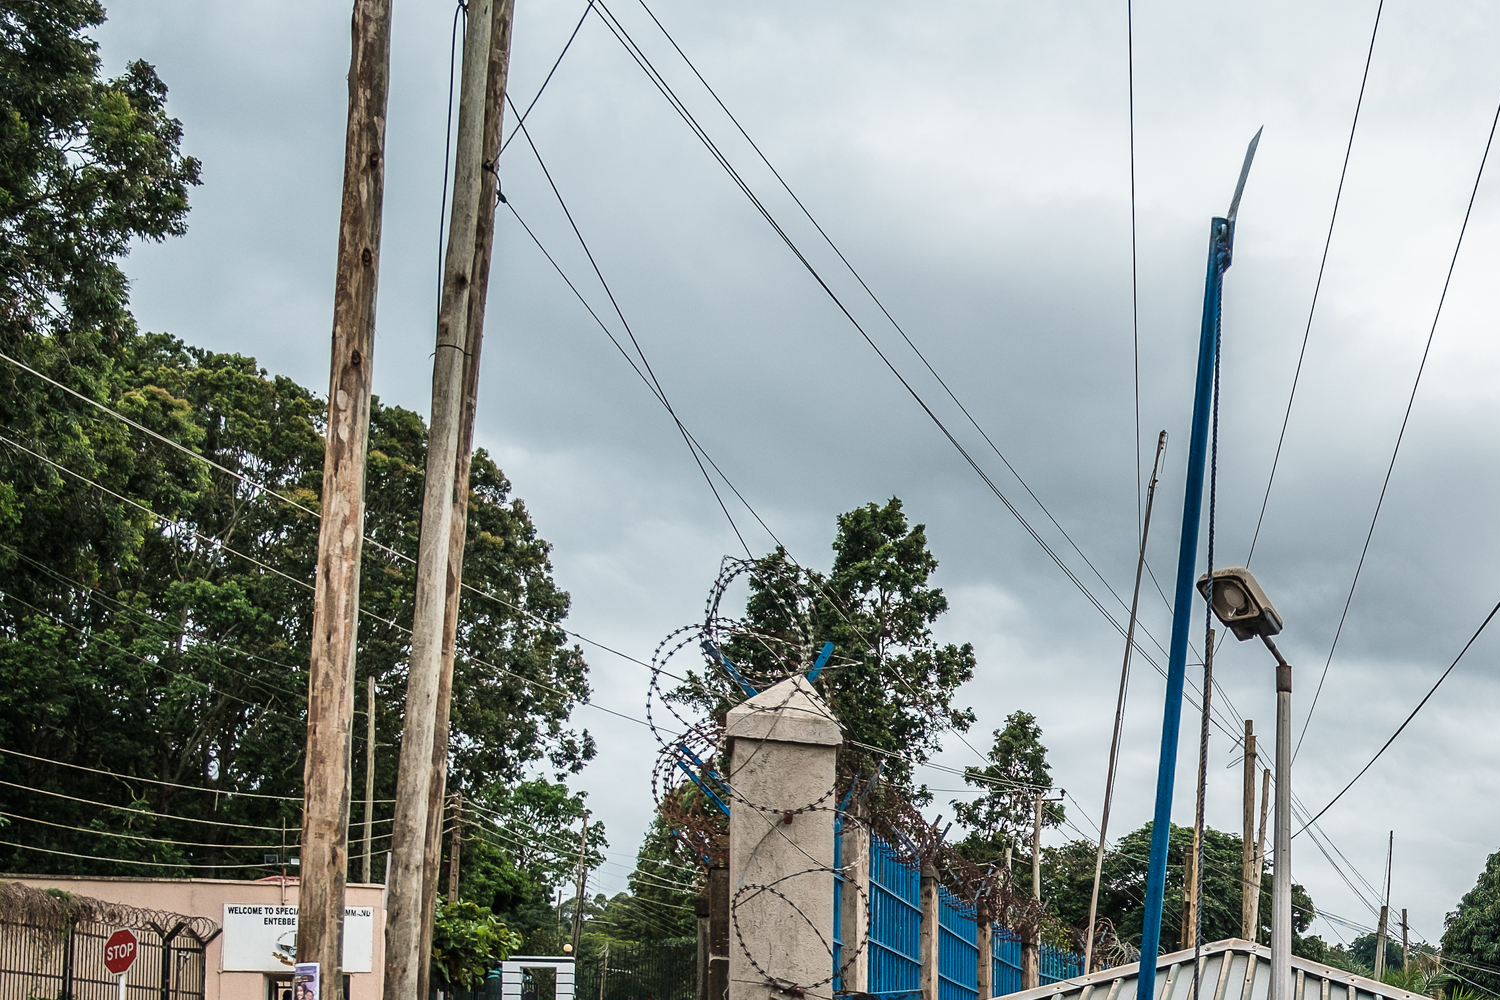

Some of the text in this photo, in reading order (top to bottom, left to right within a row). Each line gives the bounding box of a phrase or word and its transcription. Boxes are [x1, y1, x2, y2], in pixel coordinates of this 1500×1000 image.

[228, 907, 262, 915] WELCOME
[264, 907, 273, 915] TO
[264, 917, 296, 926] ENTEBBE
[106, 942, 134, 961] STOP
